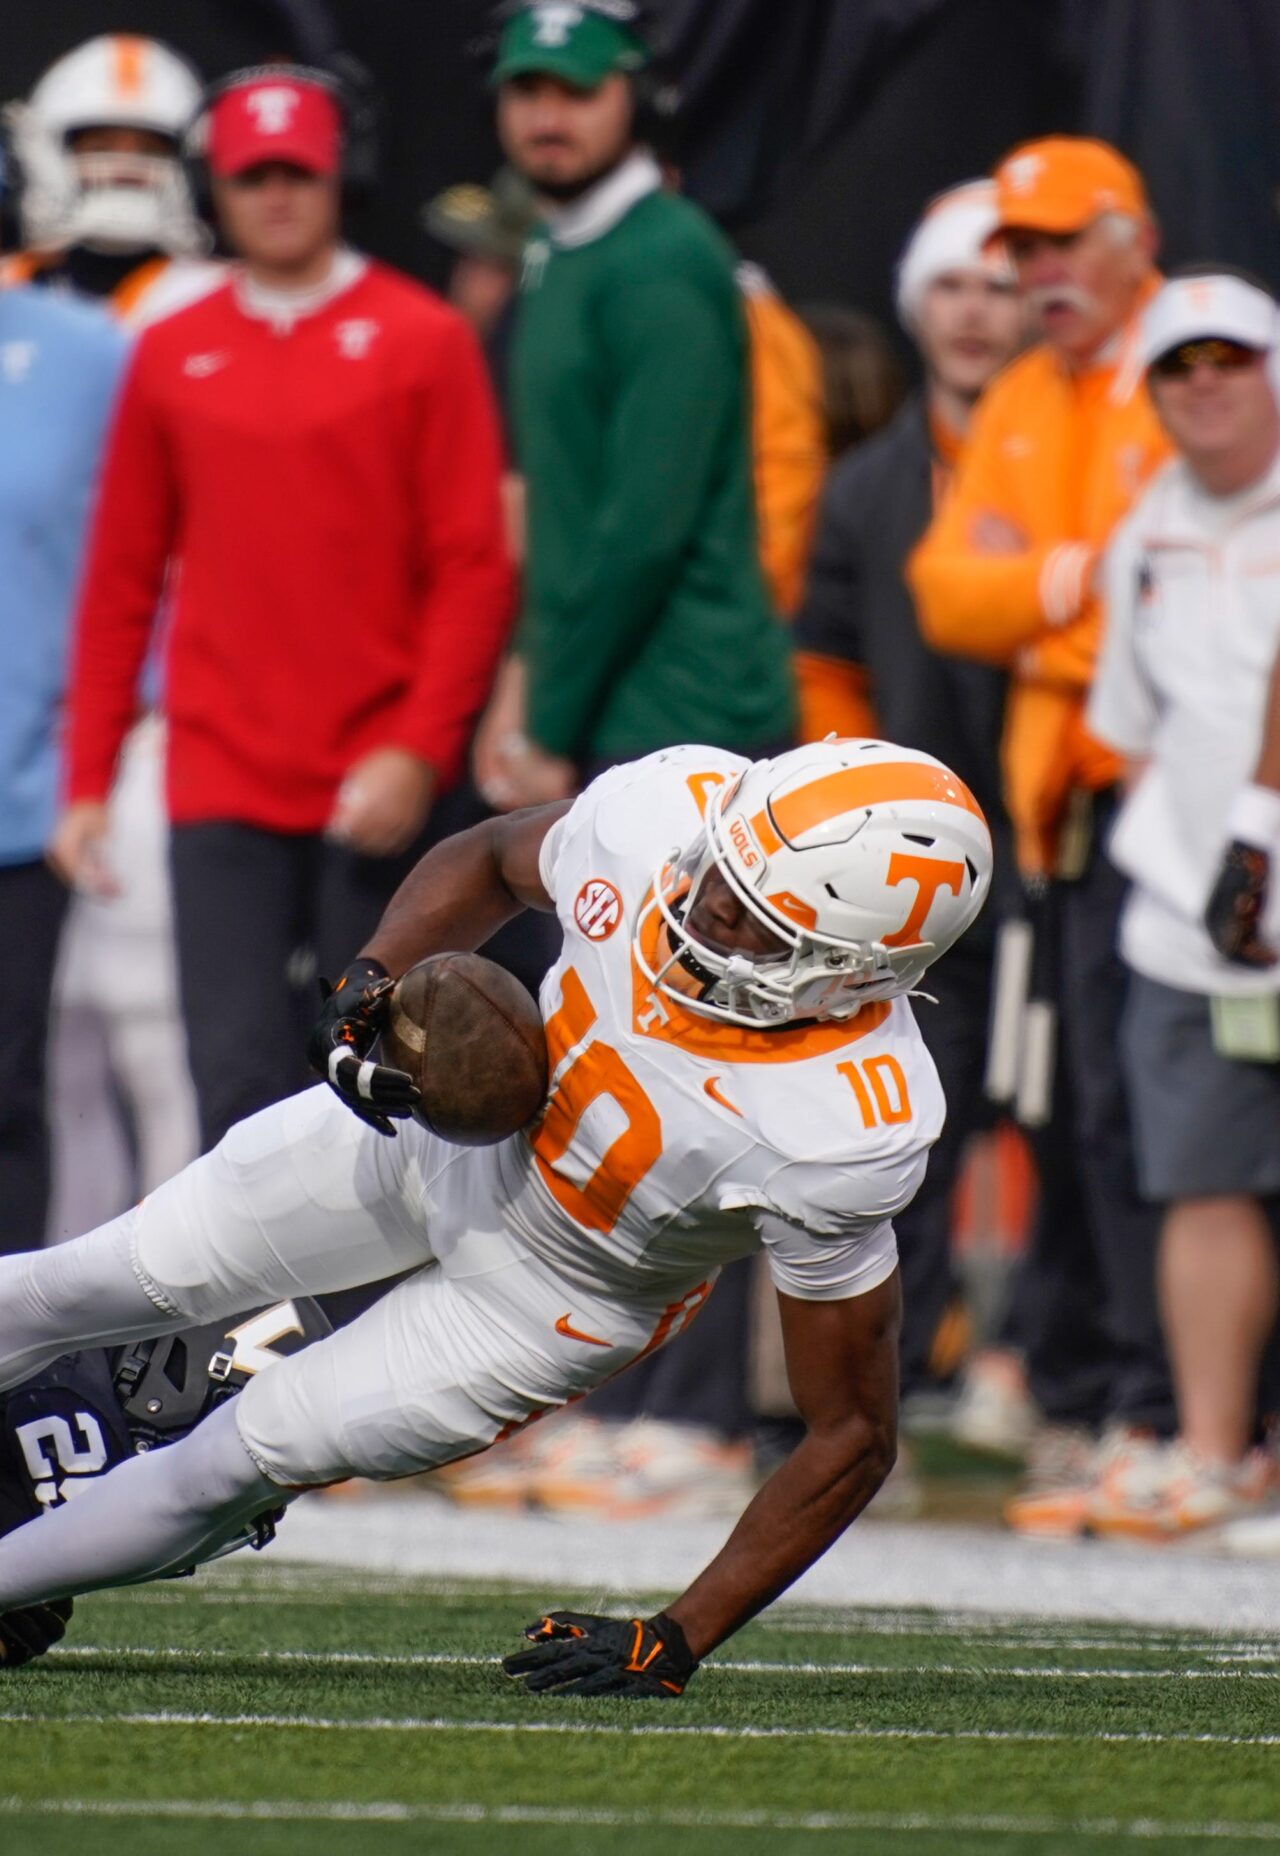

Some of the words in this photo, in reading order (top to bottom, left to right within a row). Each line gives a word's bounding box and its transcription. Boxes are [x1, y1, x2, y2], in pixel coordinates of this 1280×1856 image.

[729, 820, 759, 868] VOLS
[576, 881, 620, 937] SEC
[880, 853, 965, 947] T
[637, 991, 670, 1032] T
[835, 1053, 913, 1130] 10
